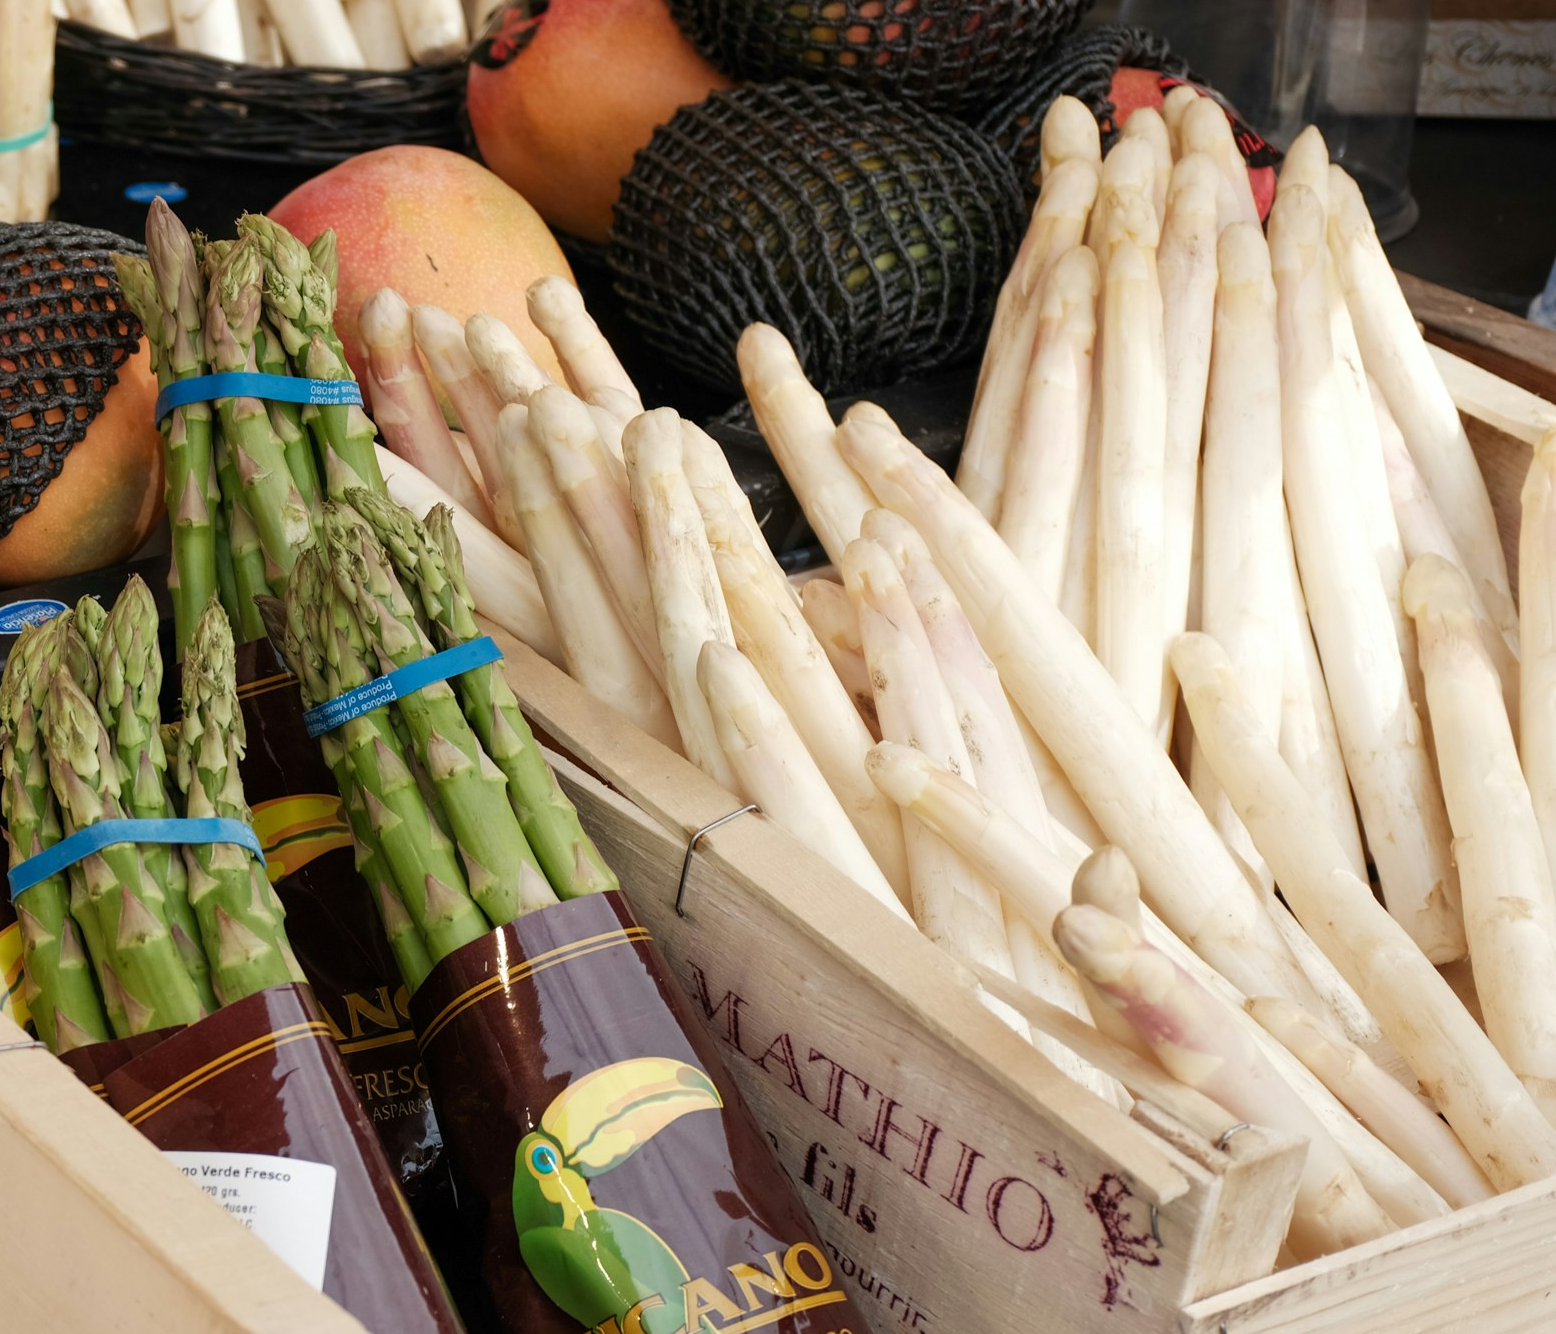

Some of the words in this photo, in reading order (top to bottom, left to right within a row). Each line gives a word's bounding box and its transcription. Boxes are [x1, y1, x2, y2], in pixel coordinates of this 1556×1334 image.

[357, 679, 393, 700] Produce
[347, 696, 357, 707] of
[361, 690, 398, 711] Produce
[351, 705, 360, 719] of
[686, 960, 1056, 1253] MATHIO
[201, 1165, 240, 1178] Verde
[244, 1167, 292, 1182] Fresco
[221, 1188, 241, 1200] grs.
[800, 1141, 879, 1234] fils
